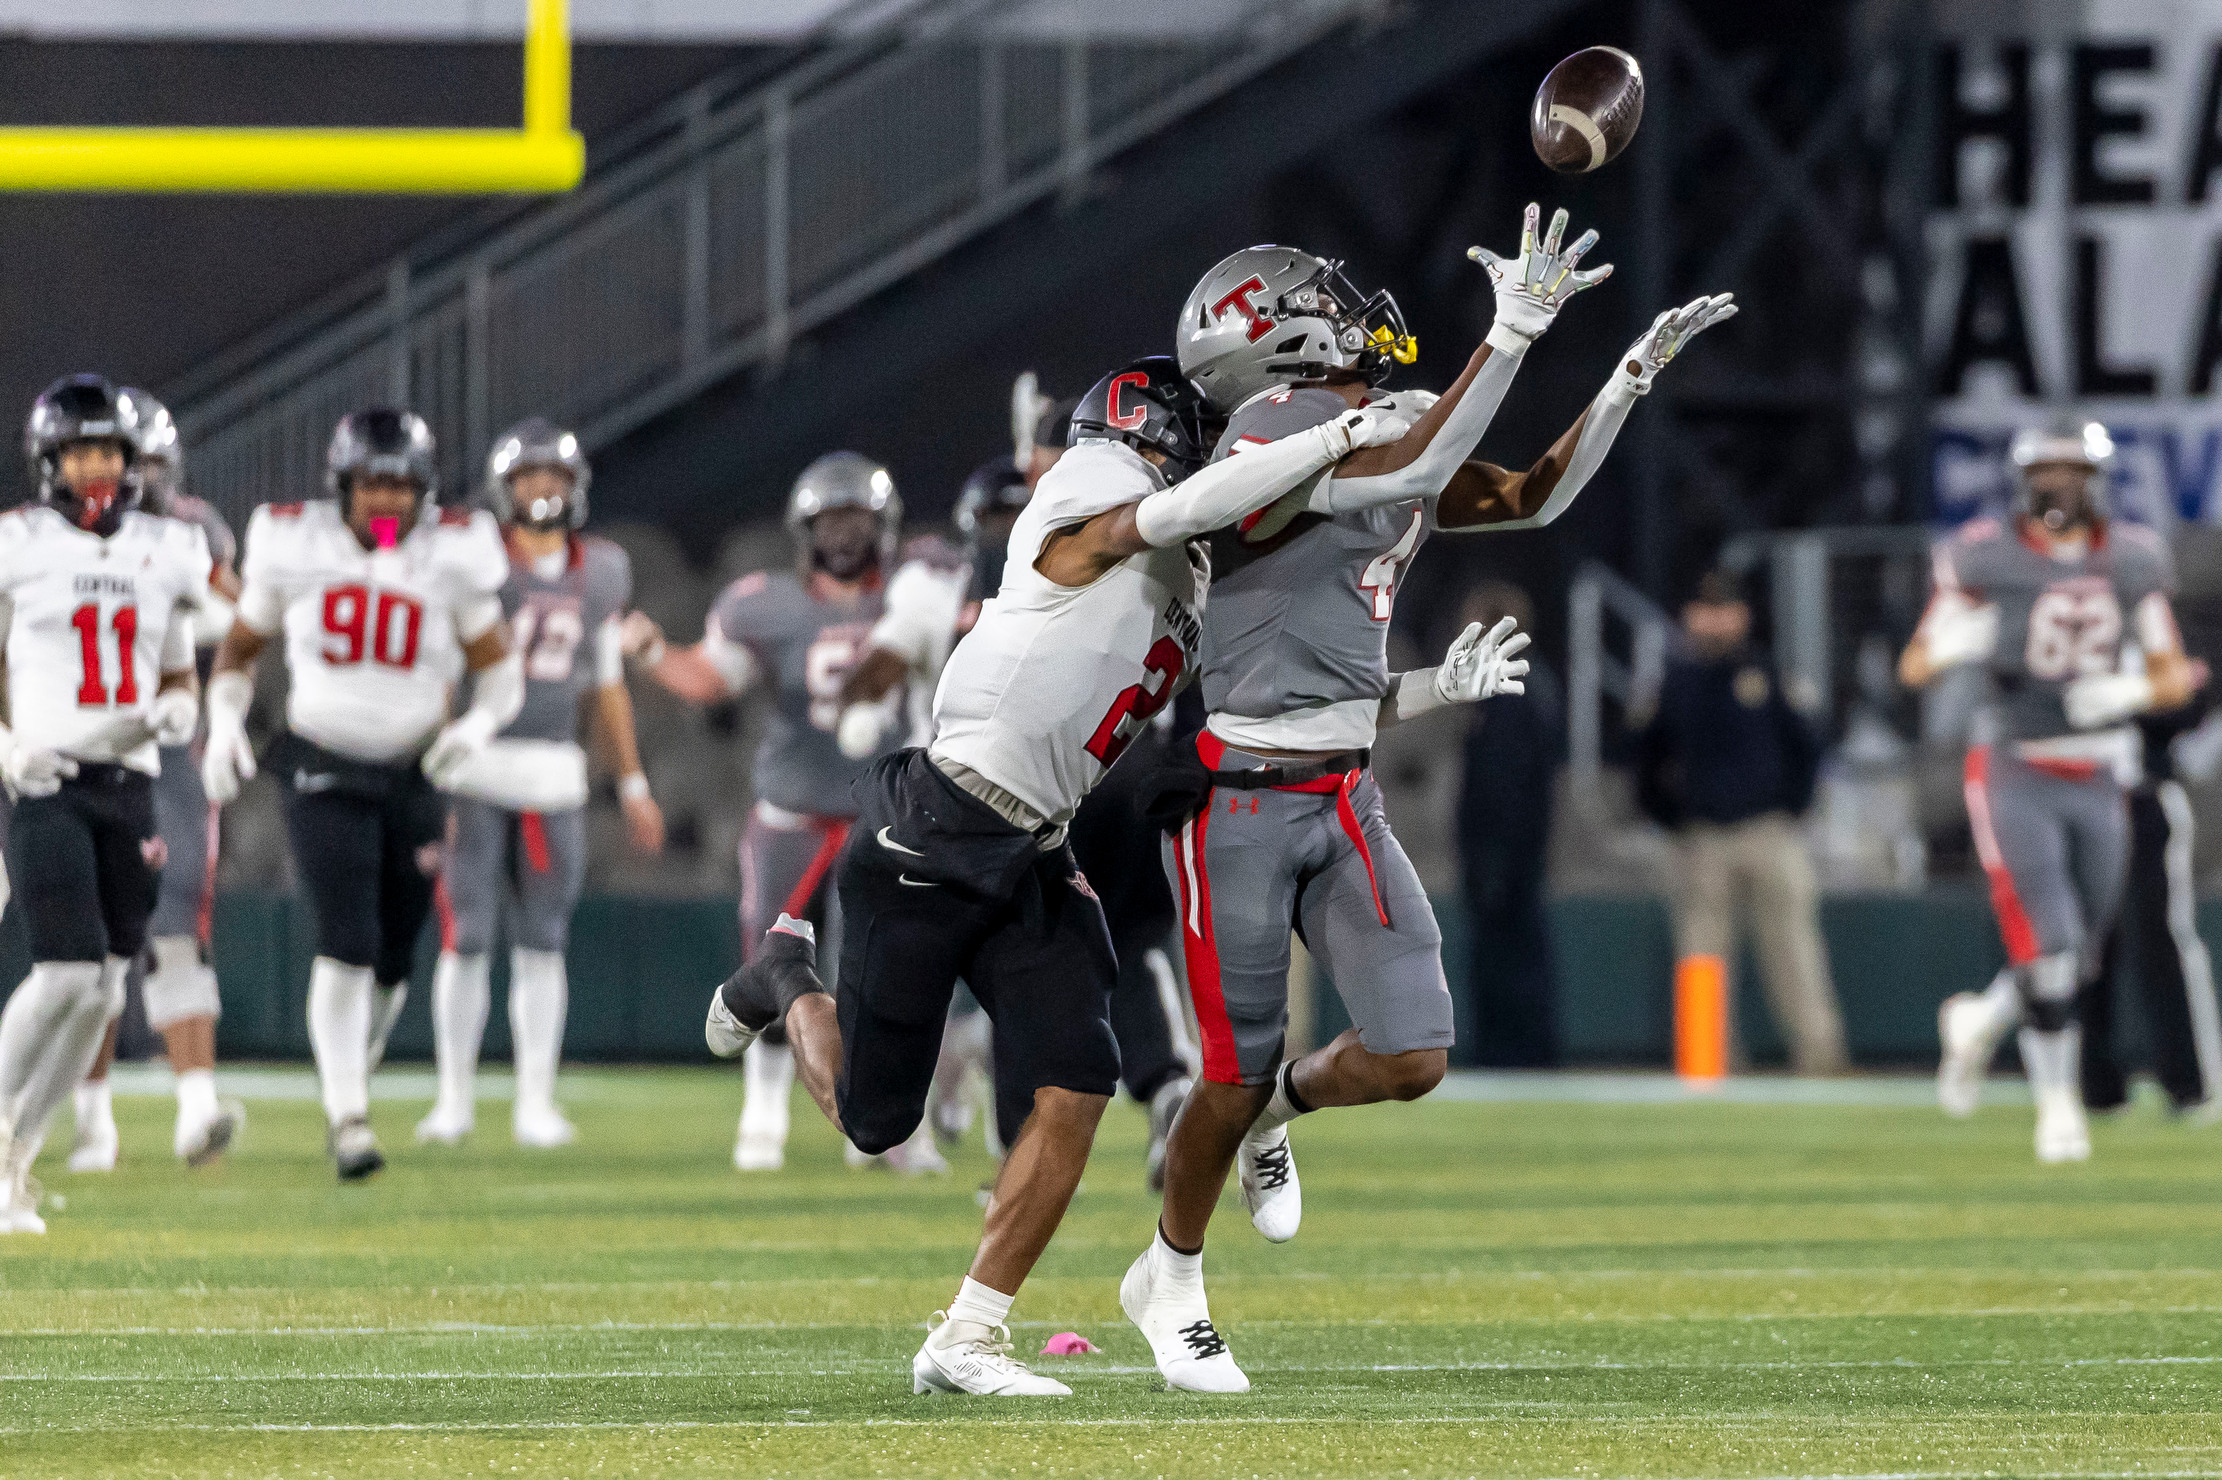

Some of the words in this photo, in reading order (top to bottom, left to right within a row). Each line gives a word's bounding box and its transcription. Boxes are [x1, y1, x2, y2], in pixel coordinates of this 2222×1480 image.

[1210, 273, 1279, 345] T
[1107, 371, 1149, 430] C
[1358, 507, 1422, 621] 4
[71, 603, 138, 706] 11
[321, 583, 424, 673] 90
[2025, 592, 2121, 680] 62
[1083, 635, 1184, 769] 2
